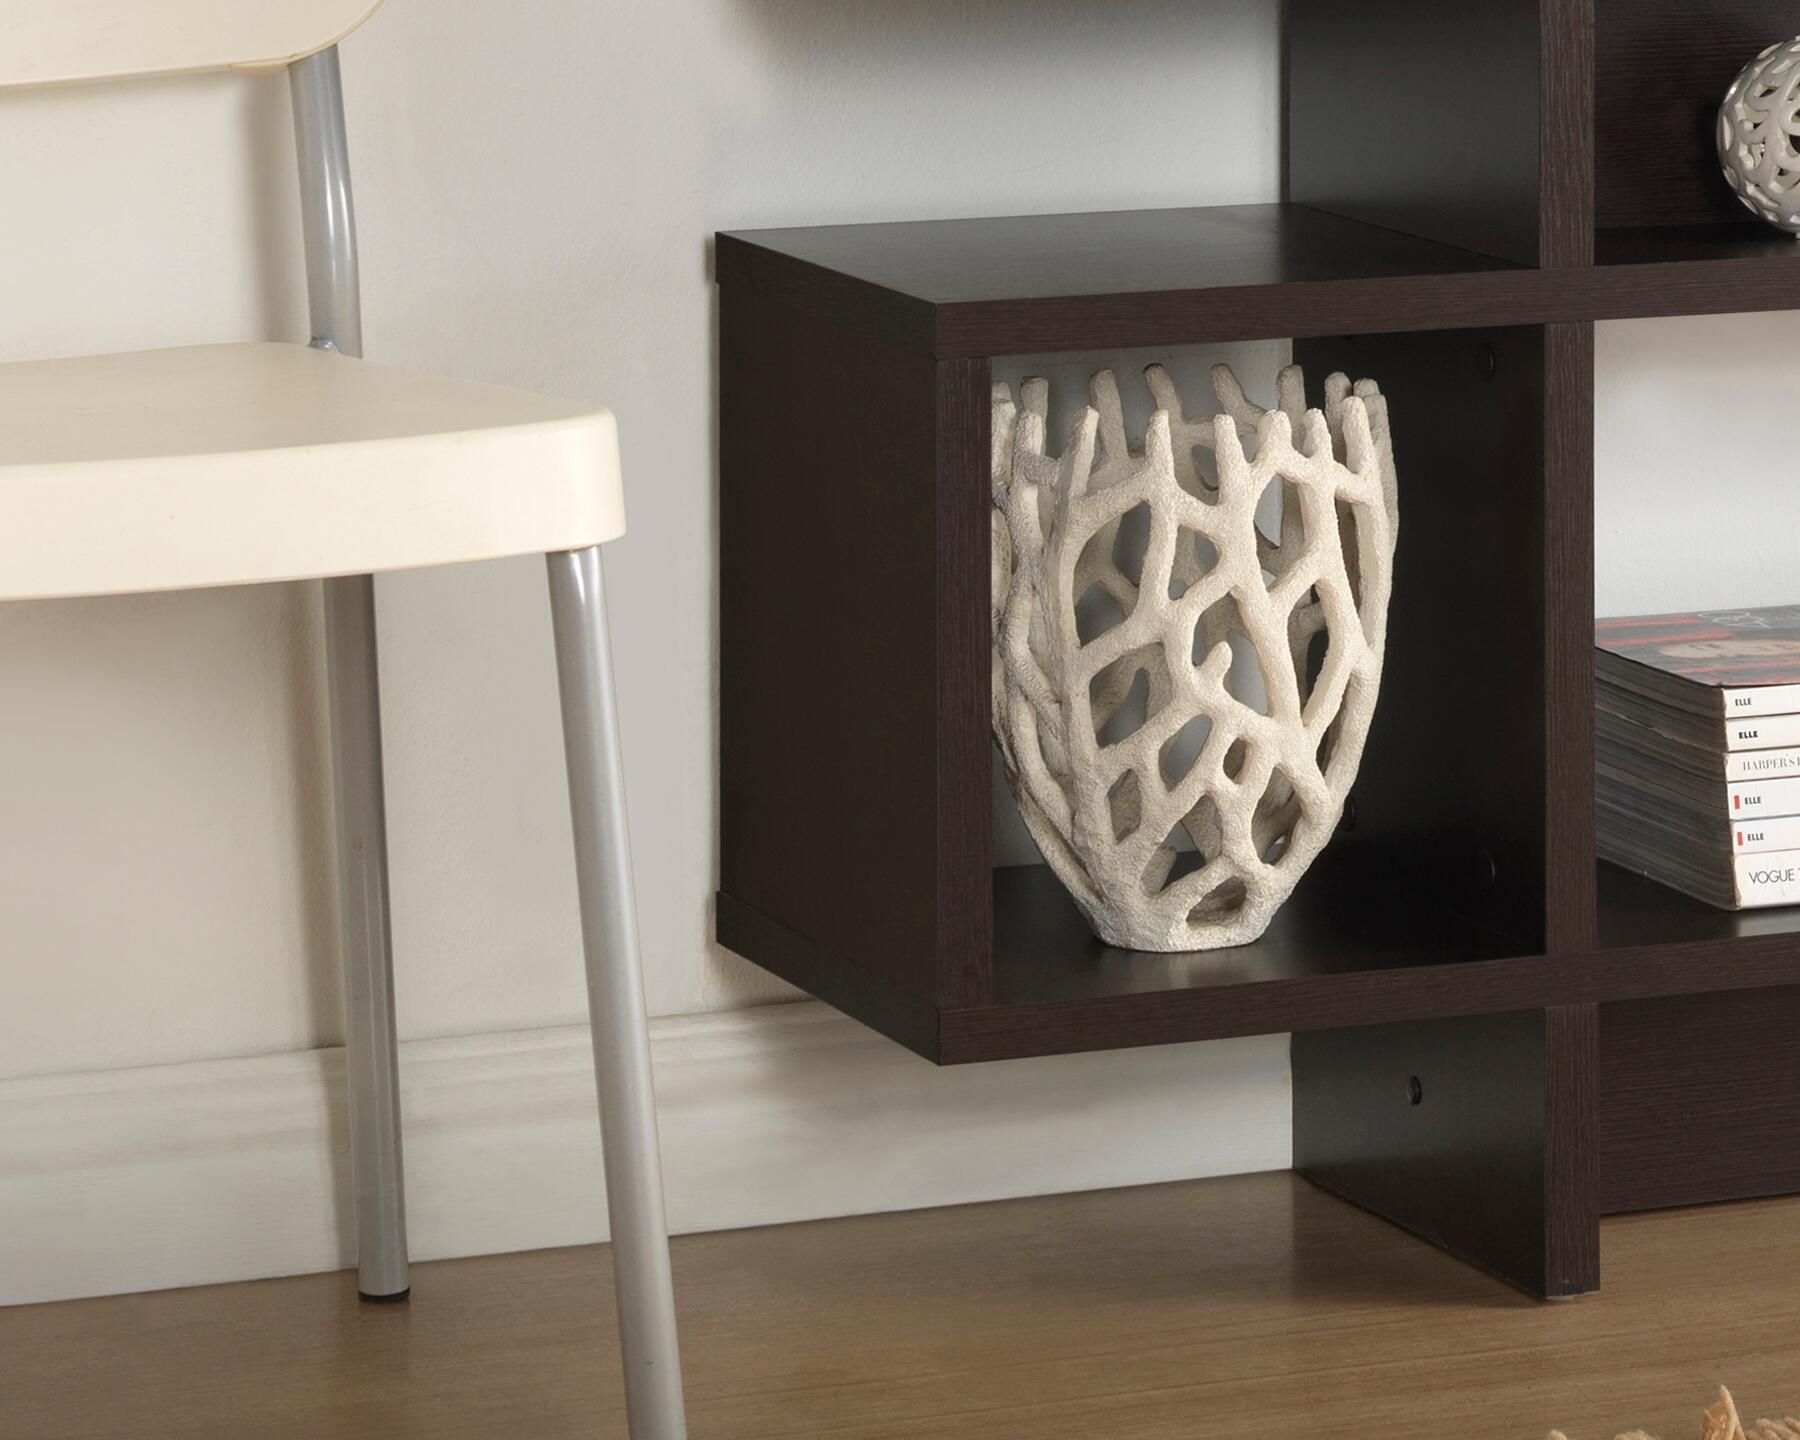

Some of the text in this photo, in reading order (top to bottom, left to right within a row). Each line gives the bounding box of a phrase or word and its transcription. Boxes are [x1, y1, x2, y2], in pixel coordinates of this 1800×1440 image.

[1735, 698, 1751, 706] ELLE
[1739, 731, 1758, 739] ELLE
[1745, 796, 1761, 804] ELLE
[1747, 833, 1764, 841] ELLE
[1749, 868, 1795, 884] VOGUE
